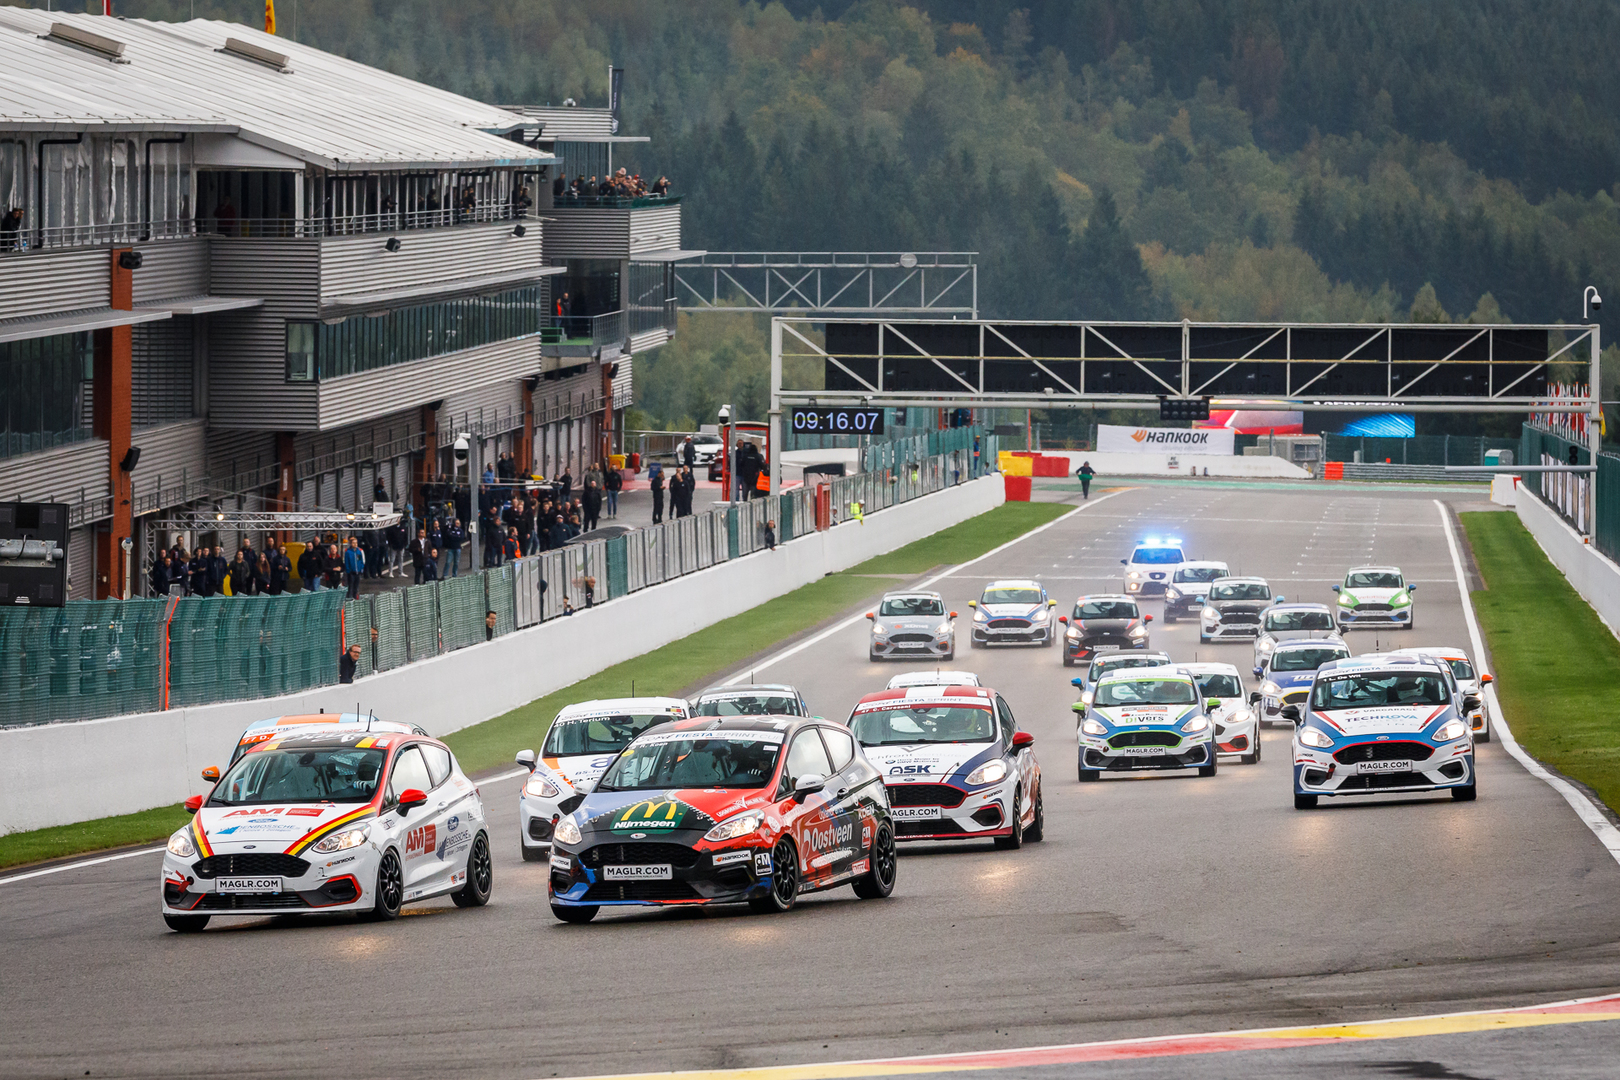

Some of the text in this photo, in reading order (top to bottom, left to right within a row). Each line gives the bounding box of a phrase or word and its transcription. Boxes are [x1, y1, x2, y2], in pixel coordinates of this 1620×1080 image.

[794, 412, 879, 431] 09:16.07
[1345, 714, 1418, 722] TECHNOVA
[890, 765, 932, 775] ASK
[1360, 762, 1409, 770] MAGLR.COM
[222, 808, 285, 818] AM
[892, 808, 938, 817] AGLR.COM
[614, 820, 676, 830] Nijmegen
[405, 825, 422, 850] AM
[812, 823, 852, 851] Oostveen
[607, 867, 668, 876] MAGLR.COM
[220, 880, 278, 888] MAGLR.COM
